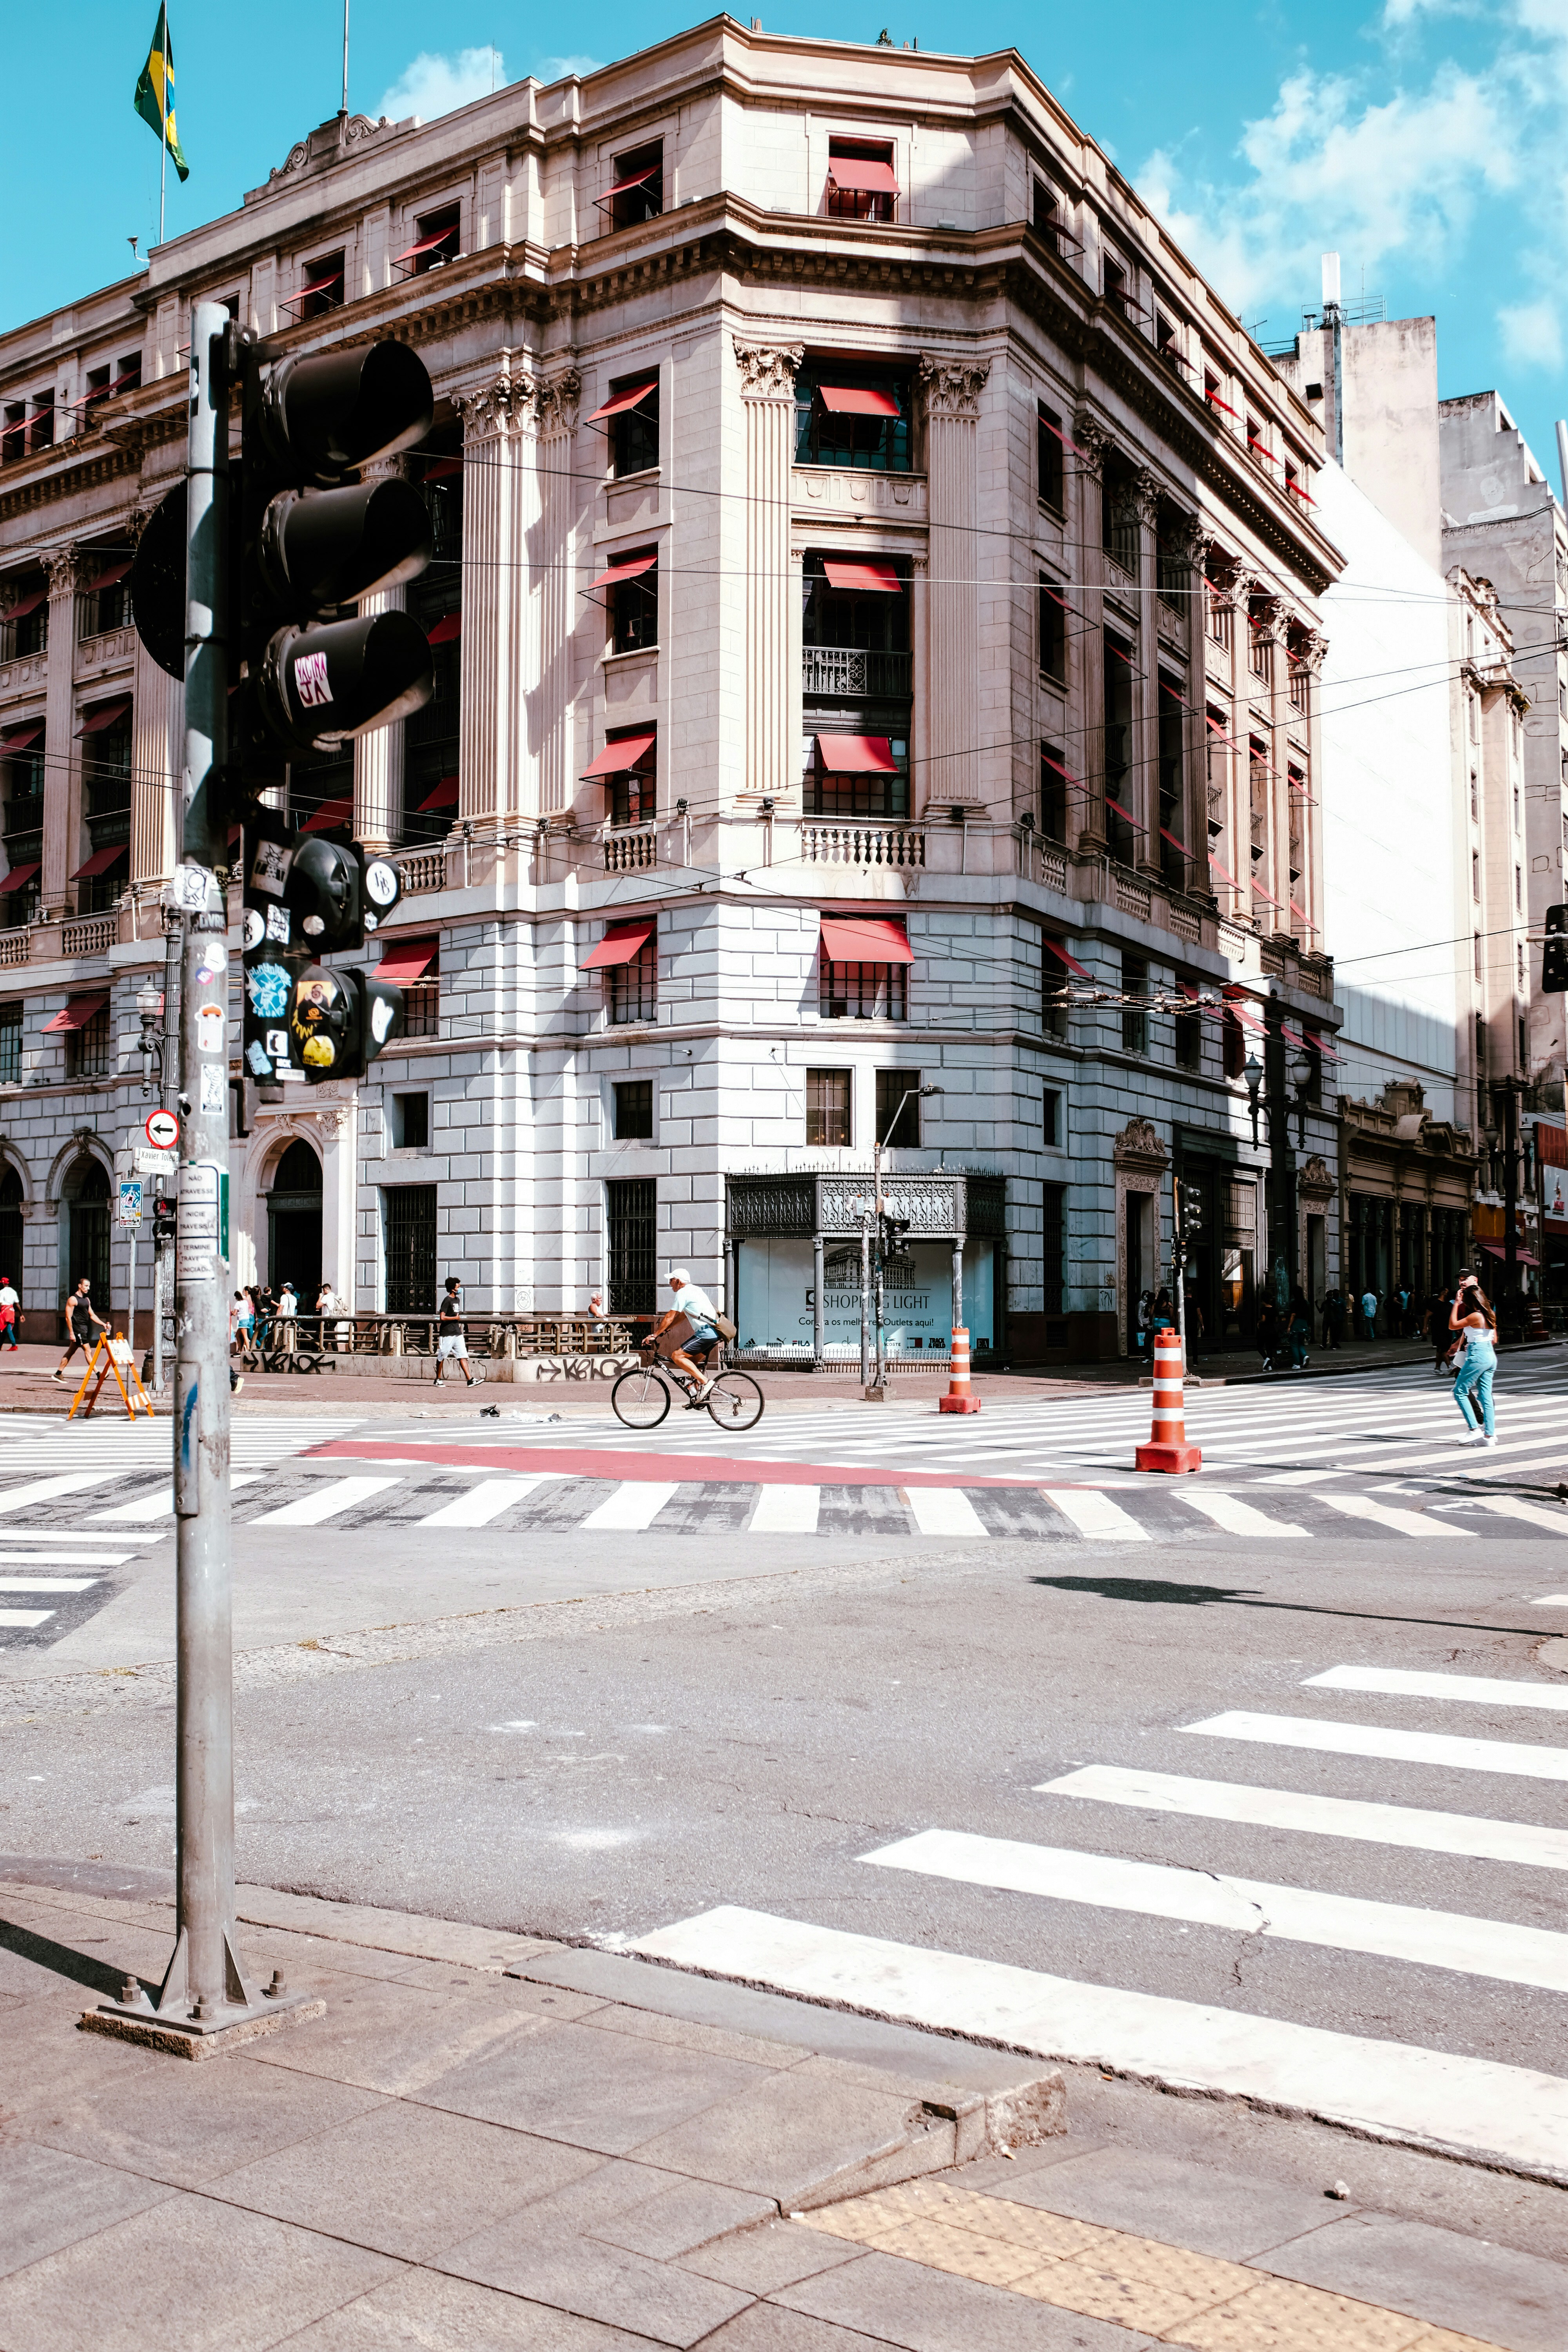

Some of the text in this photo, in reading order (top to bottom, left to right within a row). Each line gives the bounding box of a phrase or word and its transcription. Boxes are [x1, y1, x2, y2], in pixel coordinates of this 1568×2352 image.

[141, 1151, 159, 1160] Xavier
[894, 1296, 929, 1308] LIGHT
[915, 1318, 934, 1328] aqui!
